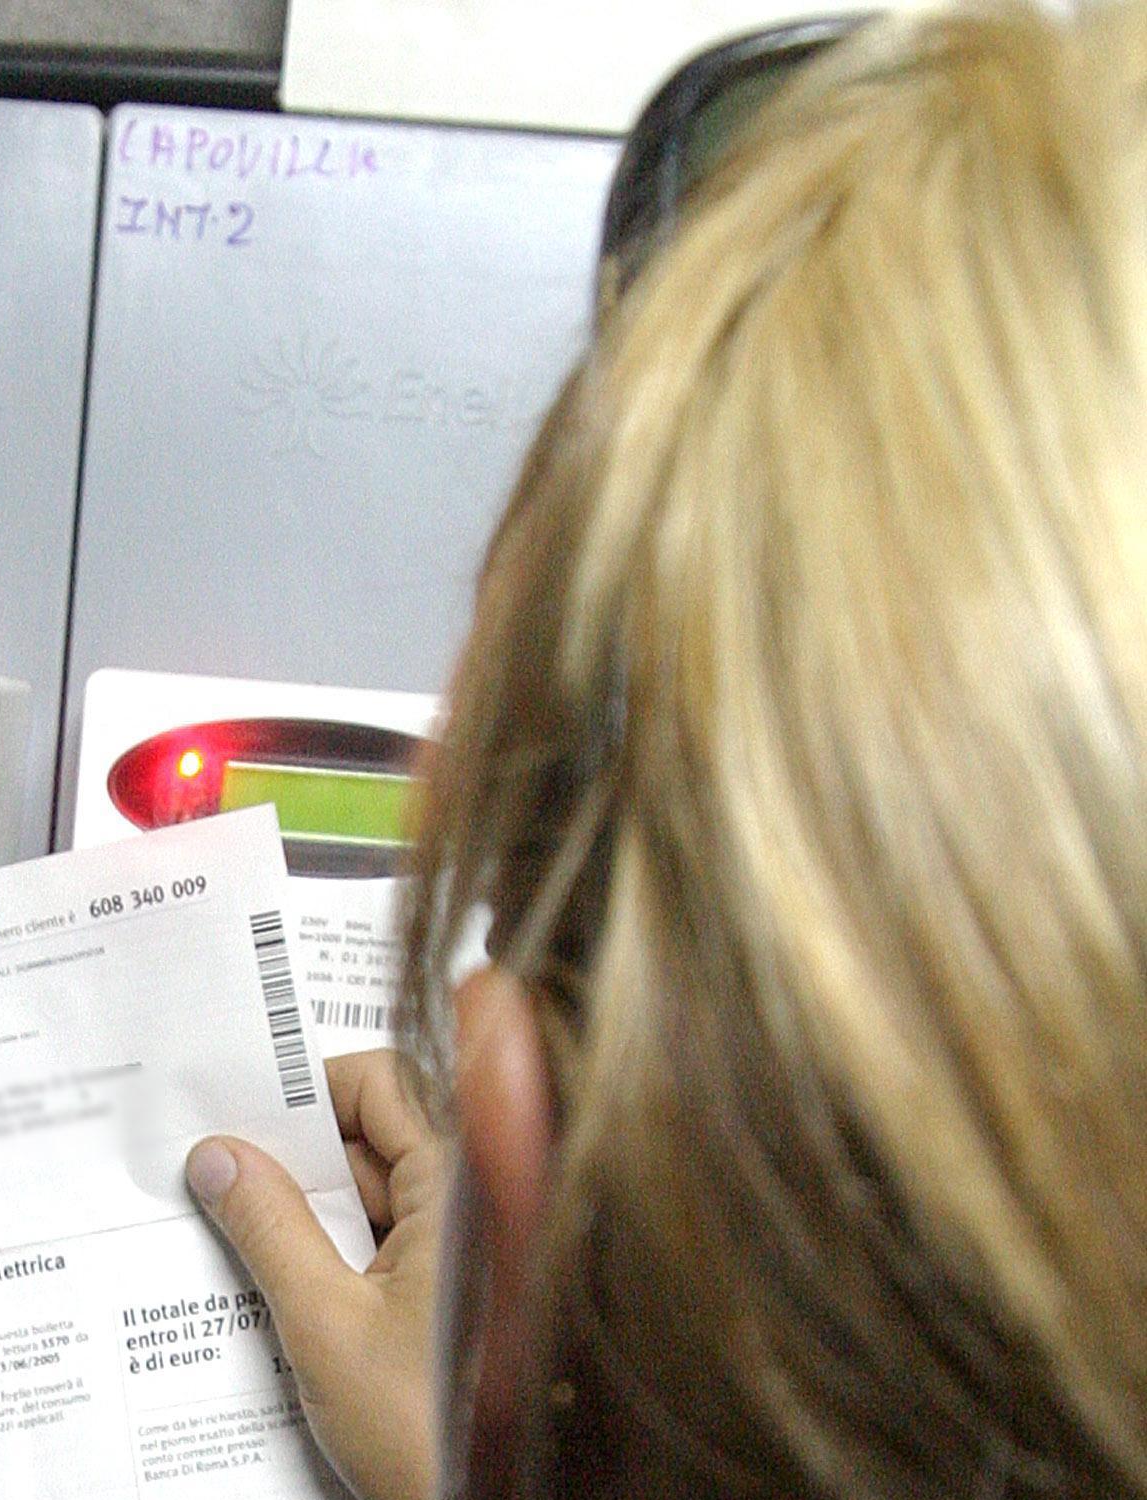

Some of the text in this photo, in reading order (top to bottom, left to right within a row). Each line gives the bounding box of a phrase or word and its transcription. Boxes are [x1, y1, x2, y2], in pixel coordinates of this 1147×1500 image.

[25, 915, 65, 934] cliente
[90, 895, 123, 918] 608
[131, 885, 164, 909] 340
[172, 876, 207, 899] 009
[123, 1309, 136, 1327] Il
[141, 1299, 199, 1323] totale
[205, 1294, 229, 1312] da
[126, 1330, 178, 1350] entro
[183, 1322, 195, 1340] il
[129, 1348, 220, 1374] è di euro:
